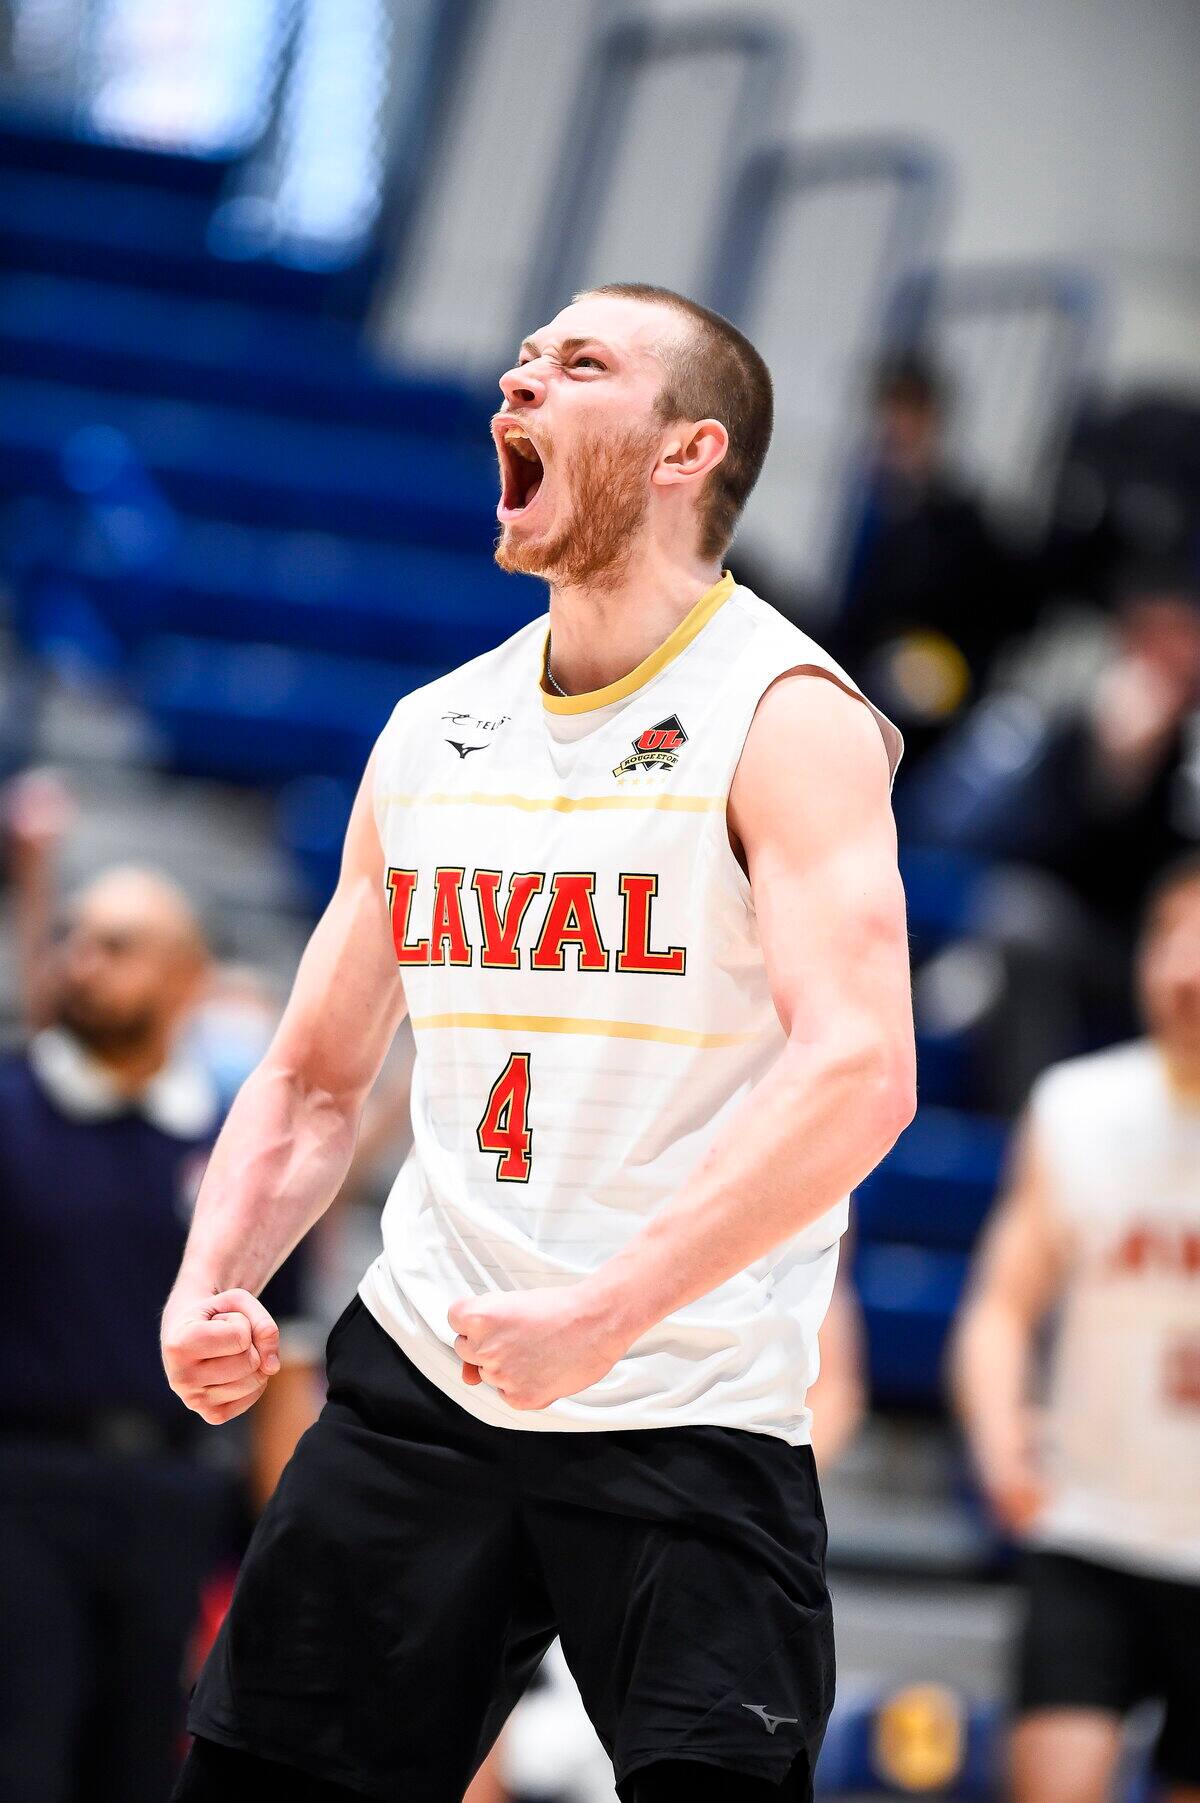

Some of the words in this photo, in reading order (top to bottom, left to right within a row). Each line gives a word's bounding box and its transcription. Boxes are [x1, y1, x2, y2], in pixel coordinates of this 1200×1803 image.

[624, 753, 656, 767] ROUGE
[638, 729, 684, 750] UL
[386, 867, 687, 976] LAVAL
[476, 1052, 533, 1183] 4
